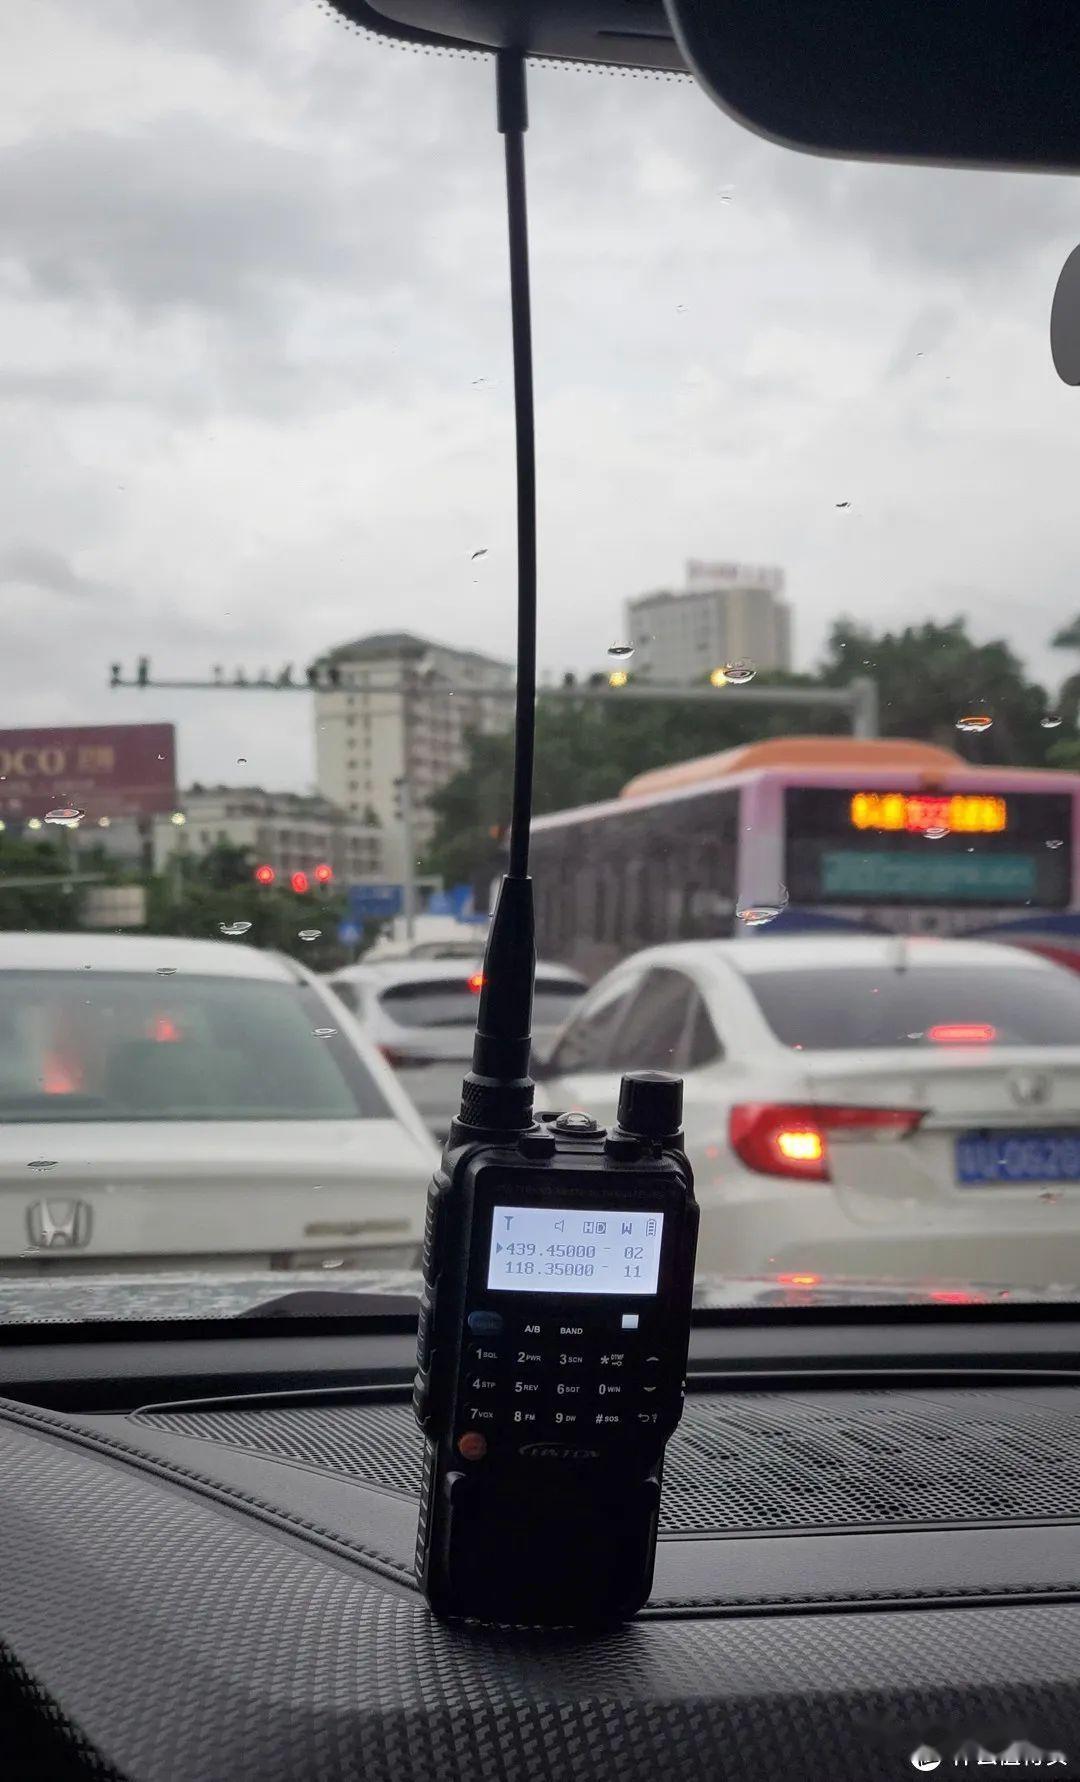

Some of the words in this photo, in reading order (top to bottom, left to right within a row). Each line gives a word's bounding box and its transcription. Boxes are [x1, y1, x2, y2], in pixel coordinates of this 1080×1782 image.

[505, 1243, 596, 1259] 439.45000
[624, 1246, 644, 1260] 02
[505, 1261, 594, 1277] 118.35000
[624, 1265, 641, 1278] 11
[524, 1324, 541, 1334] A/B
[559, 1327, 584, 1335] BAND
